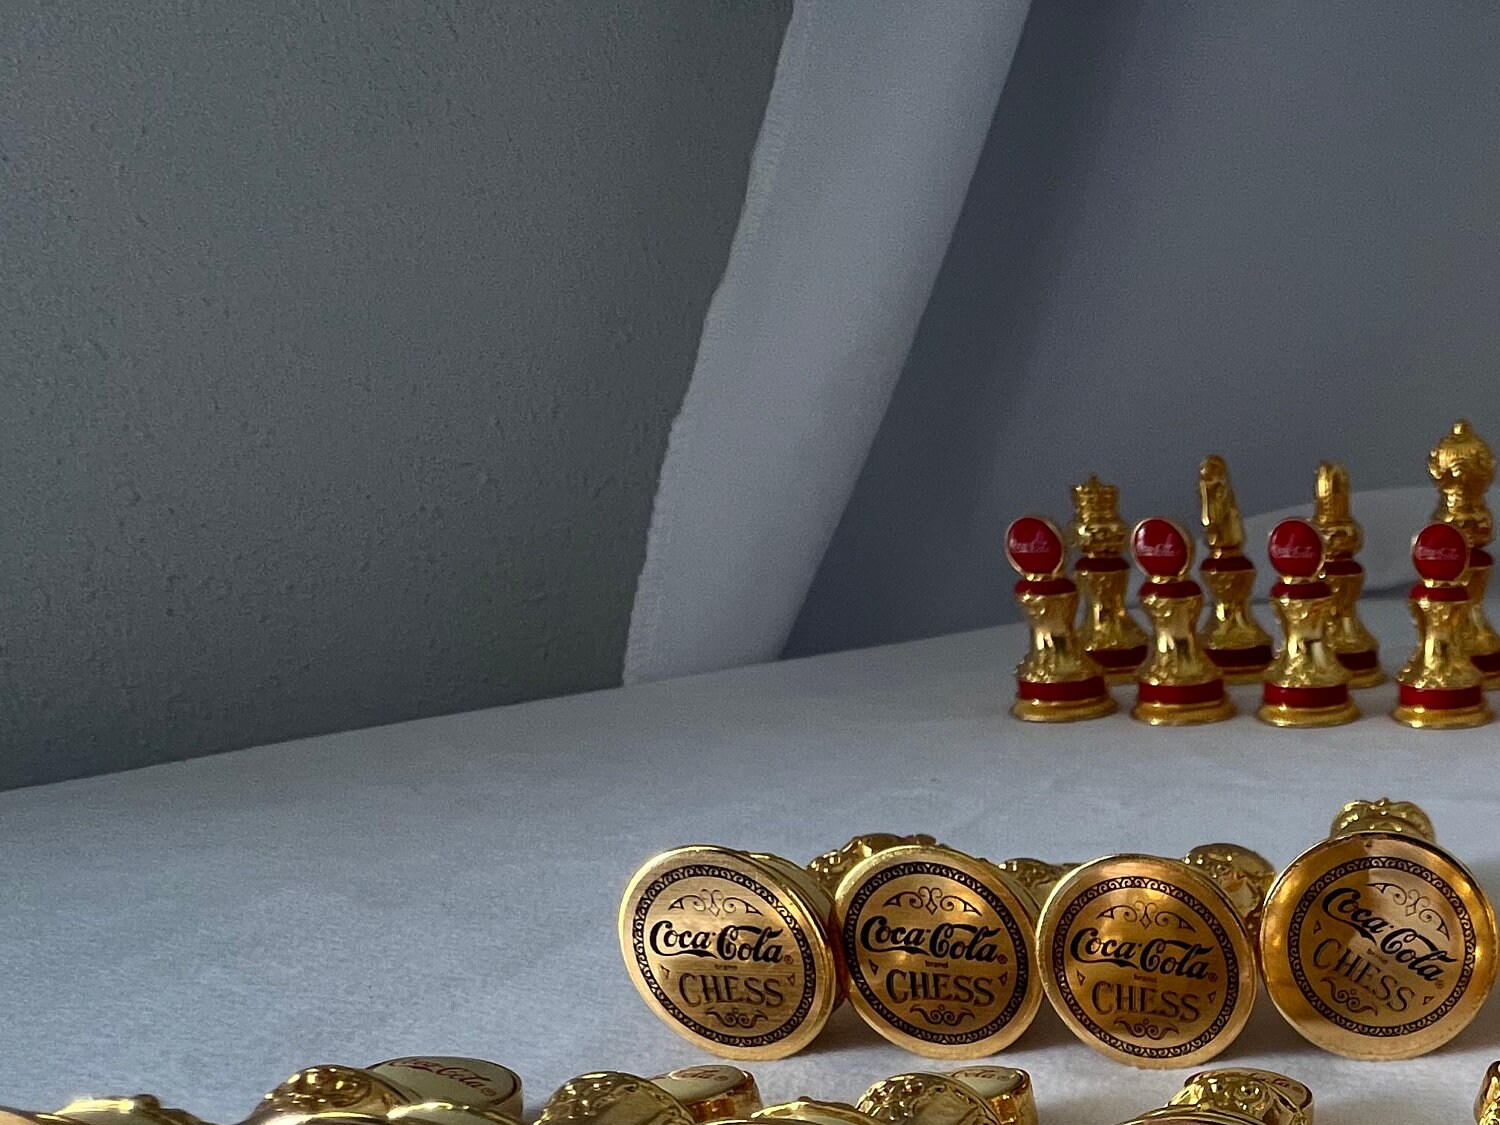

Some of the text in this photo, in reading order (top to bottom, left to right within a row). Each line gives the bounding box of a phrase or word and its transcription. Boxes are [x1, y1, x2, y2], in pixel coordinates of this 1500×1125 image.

[679, 973, 783, 1007] CHESS
[886, 969, 995, 1006] CHESS
[1313, 938, 1415, 1013] CHESS
[1092, 981, 1199, 1023] CHESS
